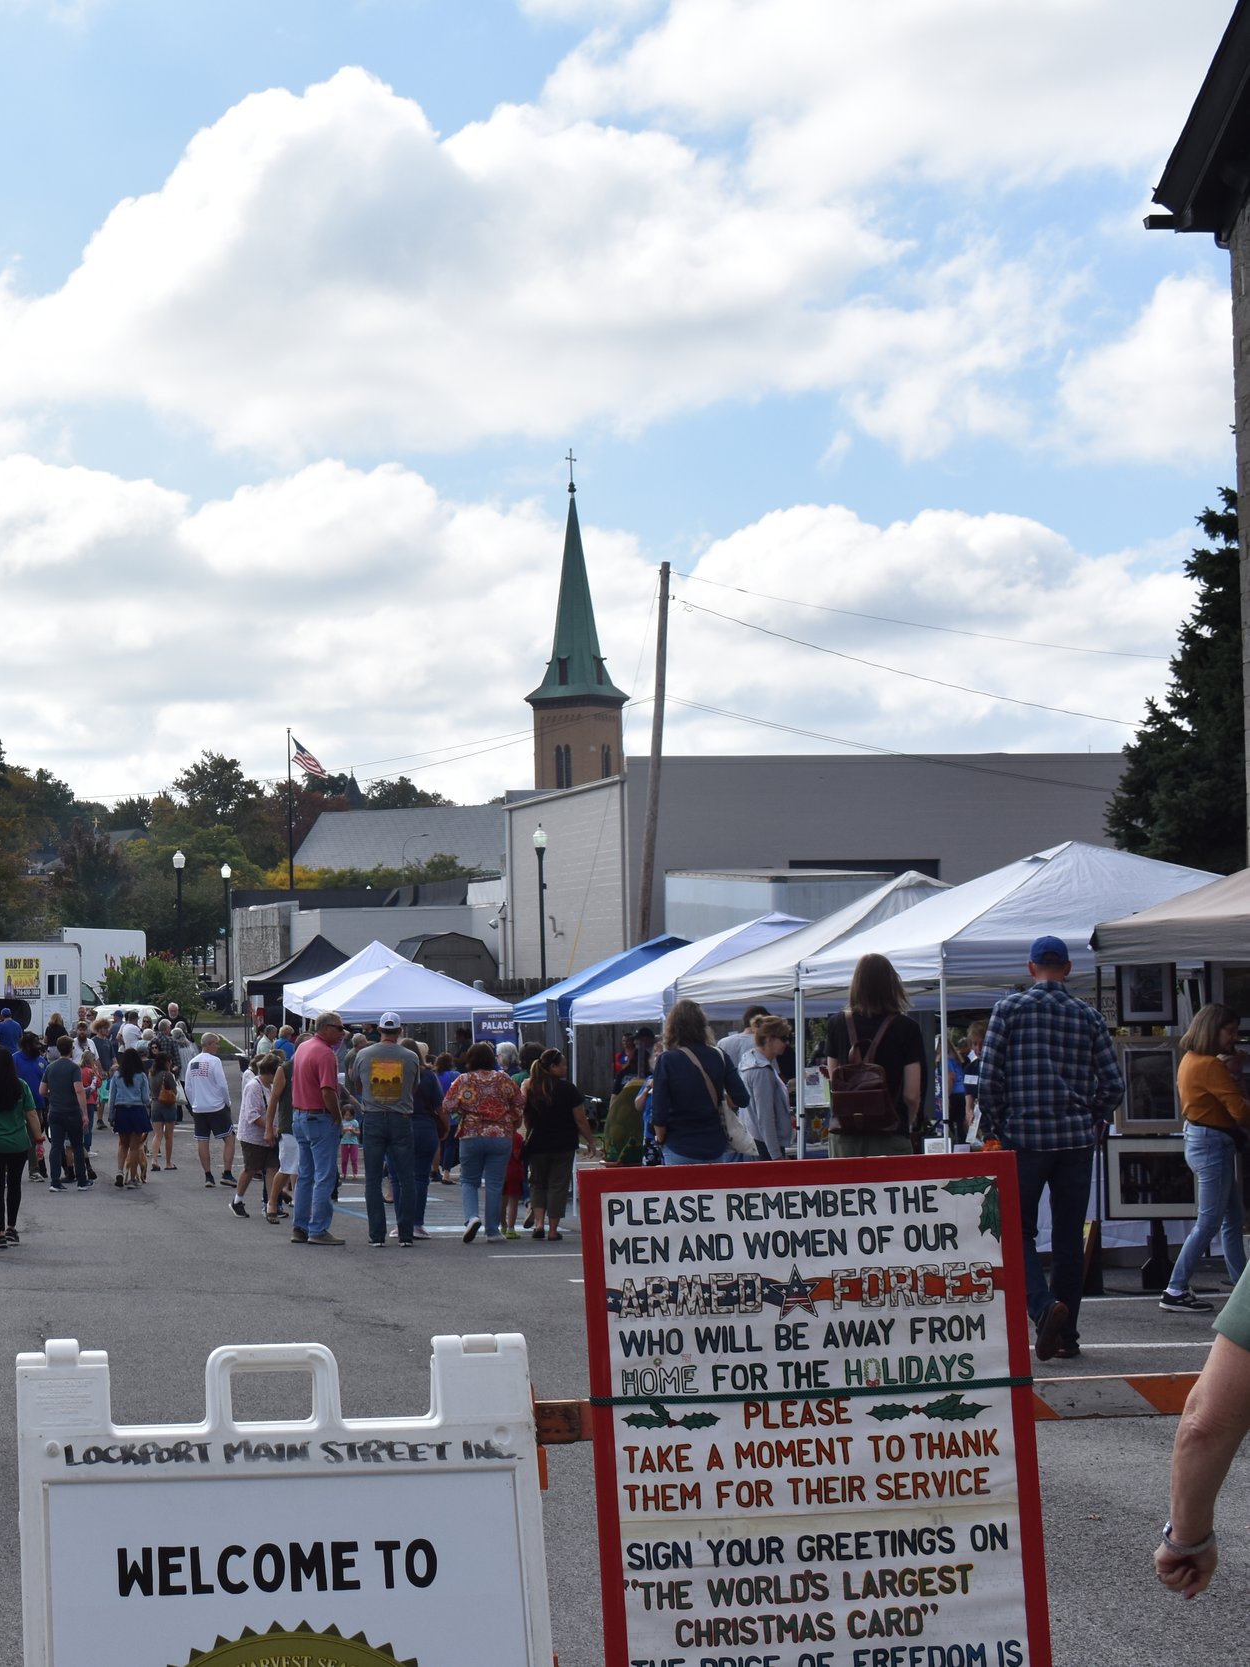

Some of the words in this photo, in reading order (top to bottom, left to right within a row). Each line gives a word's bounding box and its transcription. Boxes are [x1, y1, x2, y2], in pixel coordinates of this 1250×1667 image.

[5, 958, 21, 969] BABY
[481, 1021, 515, 1030] PALACE
[607, 1194, 716, 1227] PLEASE
[726, 1187, 877, 1222] REMEMBER
[883, 1184, 939, 1215] THE
[609, 1236, 670, 1265] MEN
[678, 1233, 734, 1263] AND
[742, 1228, 848, 1260] WOMEN
[857, 1224, 895, 1255] OF
[903, 1222, 959, 1252] OUR
[618, 1272, 763, 1319] ARMED
[831, 1261, 995, 1311] FORCES
[619, 1328, 684, 1358] WHO
[695, 1323, 763, 1355] WILL
[774, 1321, 810, 1351] BE
[822, 1318, 896, 1349] AWAY
[909, 1314, 986, 1344] FROM
[621, 1364, 699, 1396] HOME
[712, 1361, 767, 1392] FOR
[777, 1359, 831, 1389] THE
[844, 1352, 975, 1387] HOLIDAYS
[743, 1396, 853, 1430] PLEASE
[64, 1440, 212, 1467] LOCKPORT
[222, 1438, 313, 1464] MAIN
[319, 1438, 453, 1465] STREET
[622, 1443, 694, 1474] TAKE
[706, 1442, 725, 1471] A
[734, 1435, 853, 1469] MOMENT
[867, 1435, 905, 1463] TO
[910, 1428, 1000, 1460] THANK
[622, 1481, 702, 1512] THEM
[716, 1479, 774, 1508] FOR
[785, 1474, 866, 1505] THEIR
[875, 1466, 991, 1501] SERVICE
[116, 1540, 361, 1598] WELCOME
[374, 1538, 438, 1590] TO
[626, 1539, 693, 1571] SIGN
[705, 1535, 785, 1568] YOUR
[796, 1525, 956, 1562] GREETINGS
[970, 1522, 1009, 1552] ON
[707, 1568, 830, 1607] WORLD'S
[842, 1563, 974, 1600] LARGEST
[674, 1611, 836, 1648] CHRISTMAS
[853, 1642, 986, 1667] FREEDOM
[996, 1639, 1024, 1667] IS
